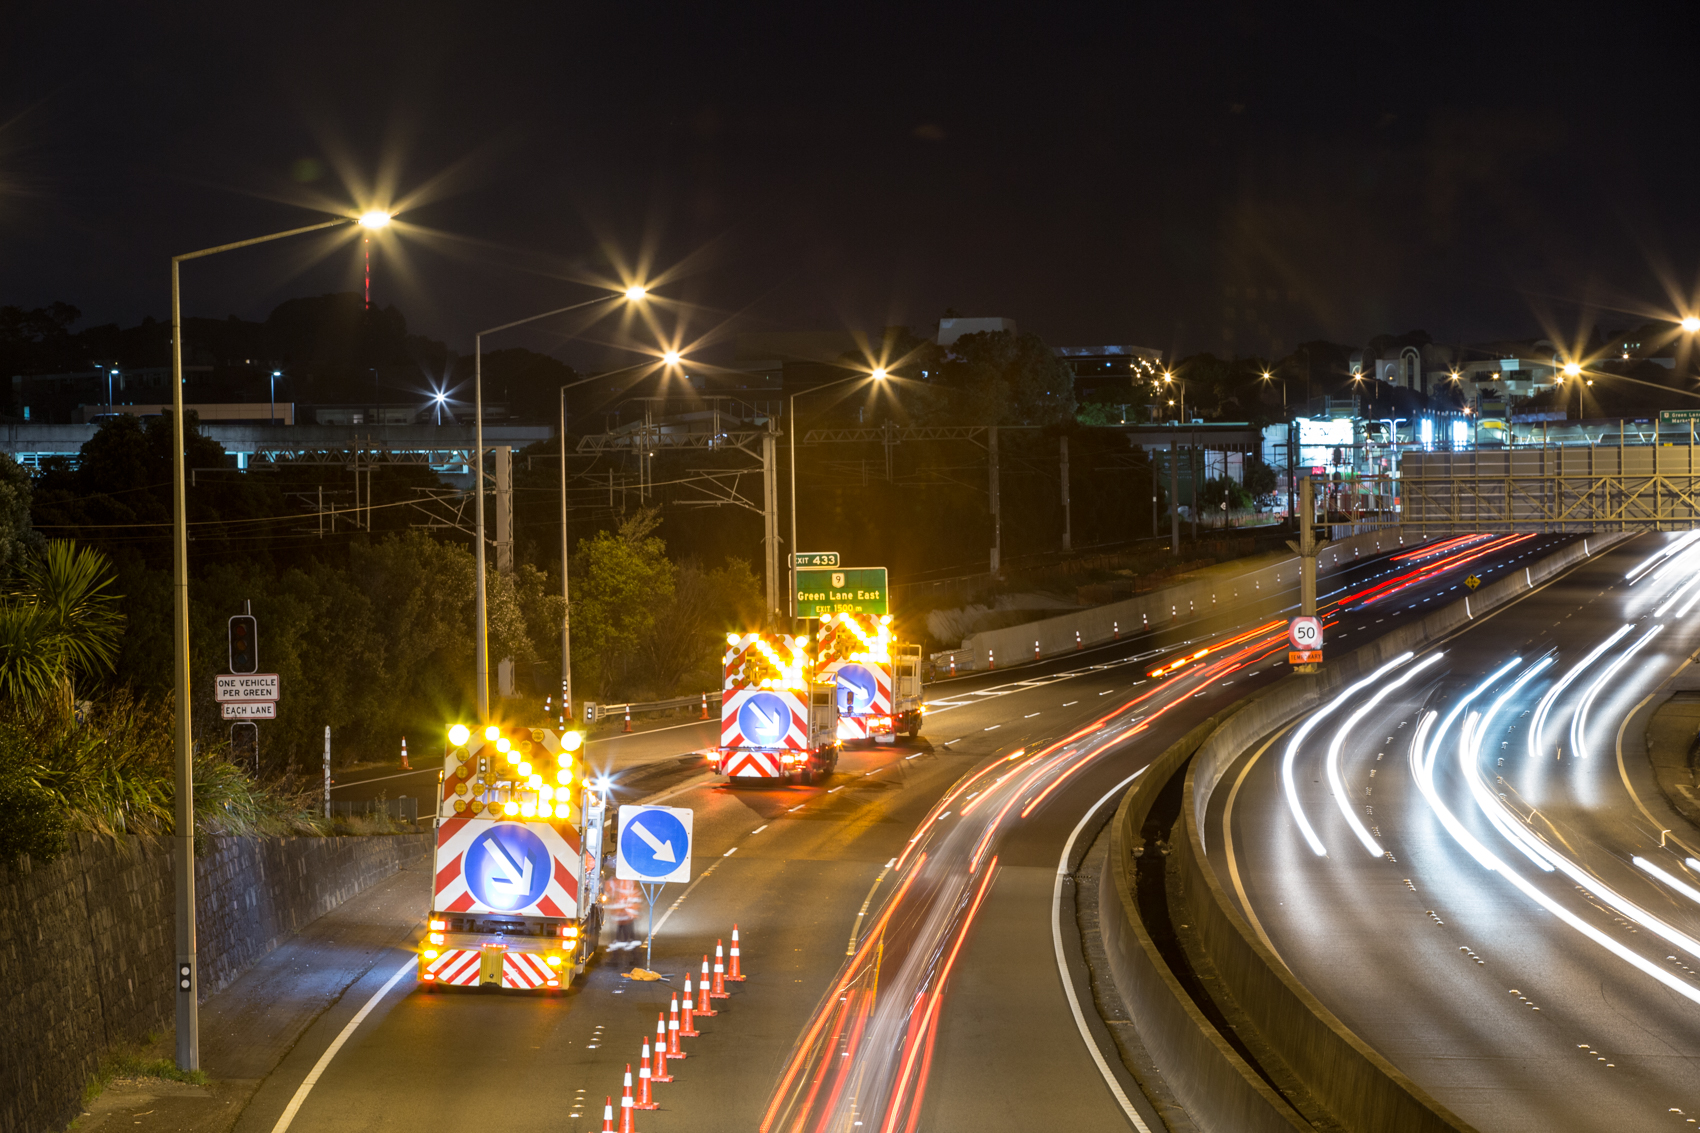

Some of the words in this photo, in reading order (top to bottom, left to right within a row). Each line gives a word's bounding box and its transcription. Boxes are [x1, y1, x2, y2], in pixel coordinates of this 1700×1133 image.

[812, 555, 836, 565] 433
[836, 575, 841, 583] 9
[797, 591, 826, 601] Green
[829, 591, 853, 600] Lane
[857, 590, 880, 600] East
[834, 604, 854, 612] 1500
[1297, 626, 1315, 639] 50
[239, 679, 276, 687] VEHICLE
[223, 689, 240, 697] PER
[225, 706, 247, 715] EACH
[250, 706, 272, 714] LANE
